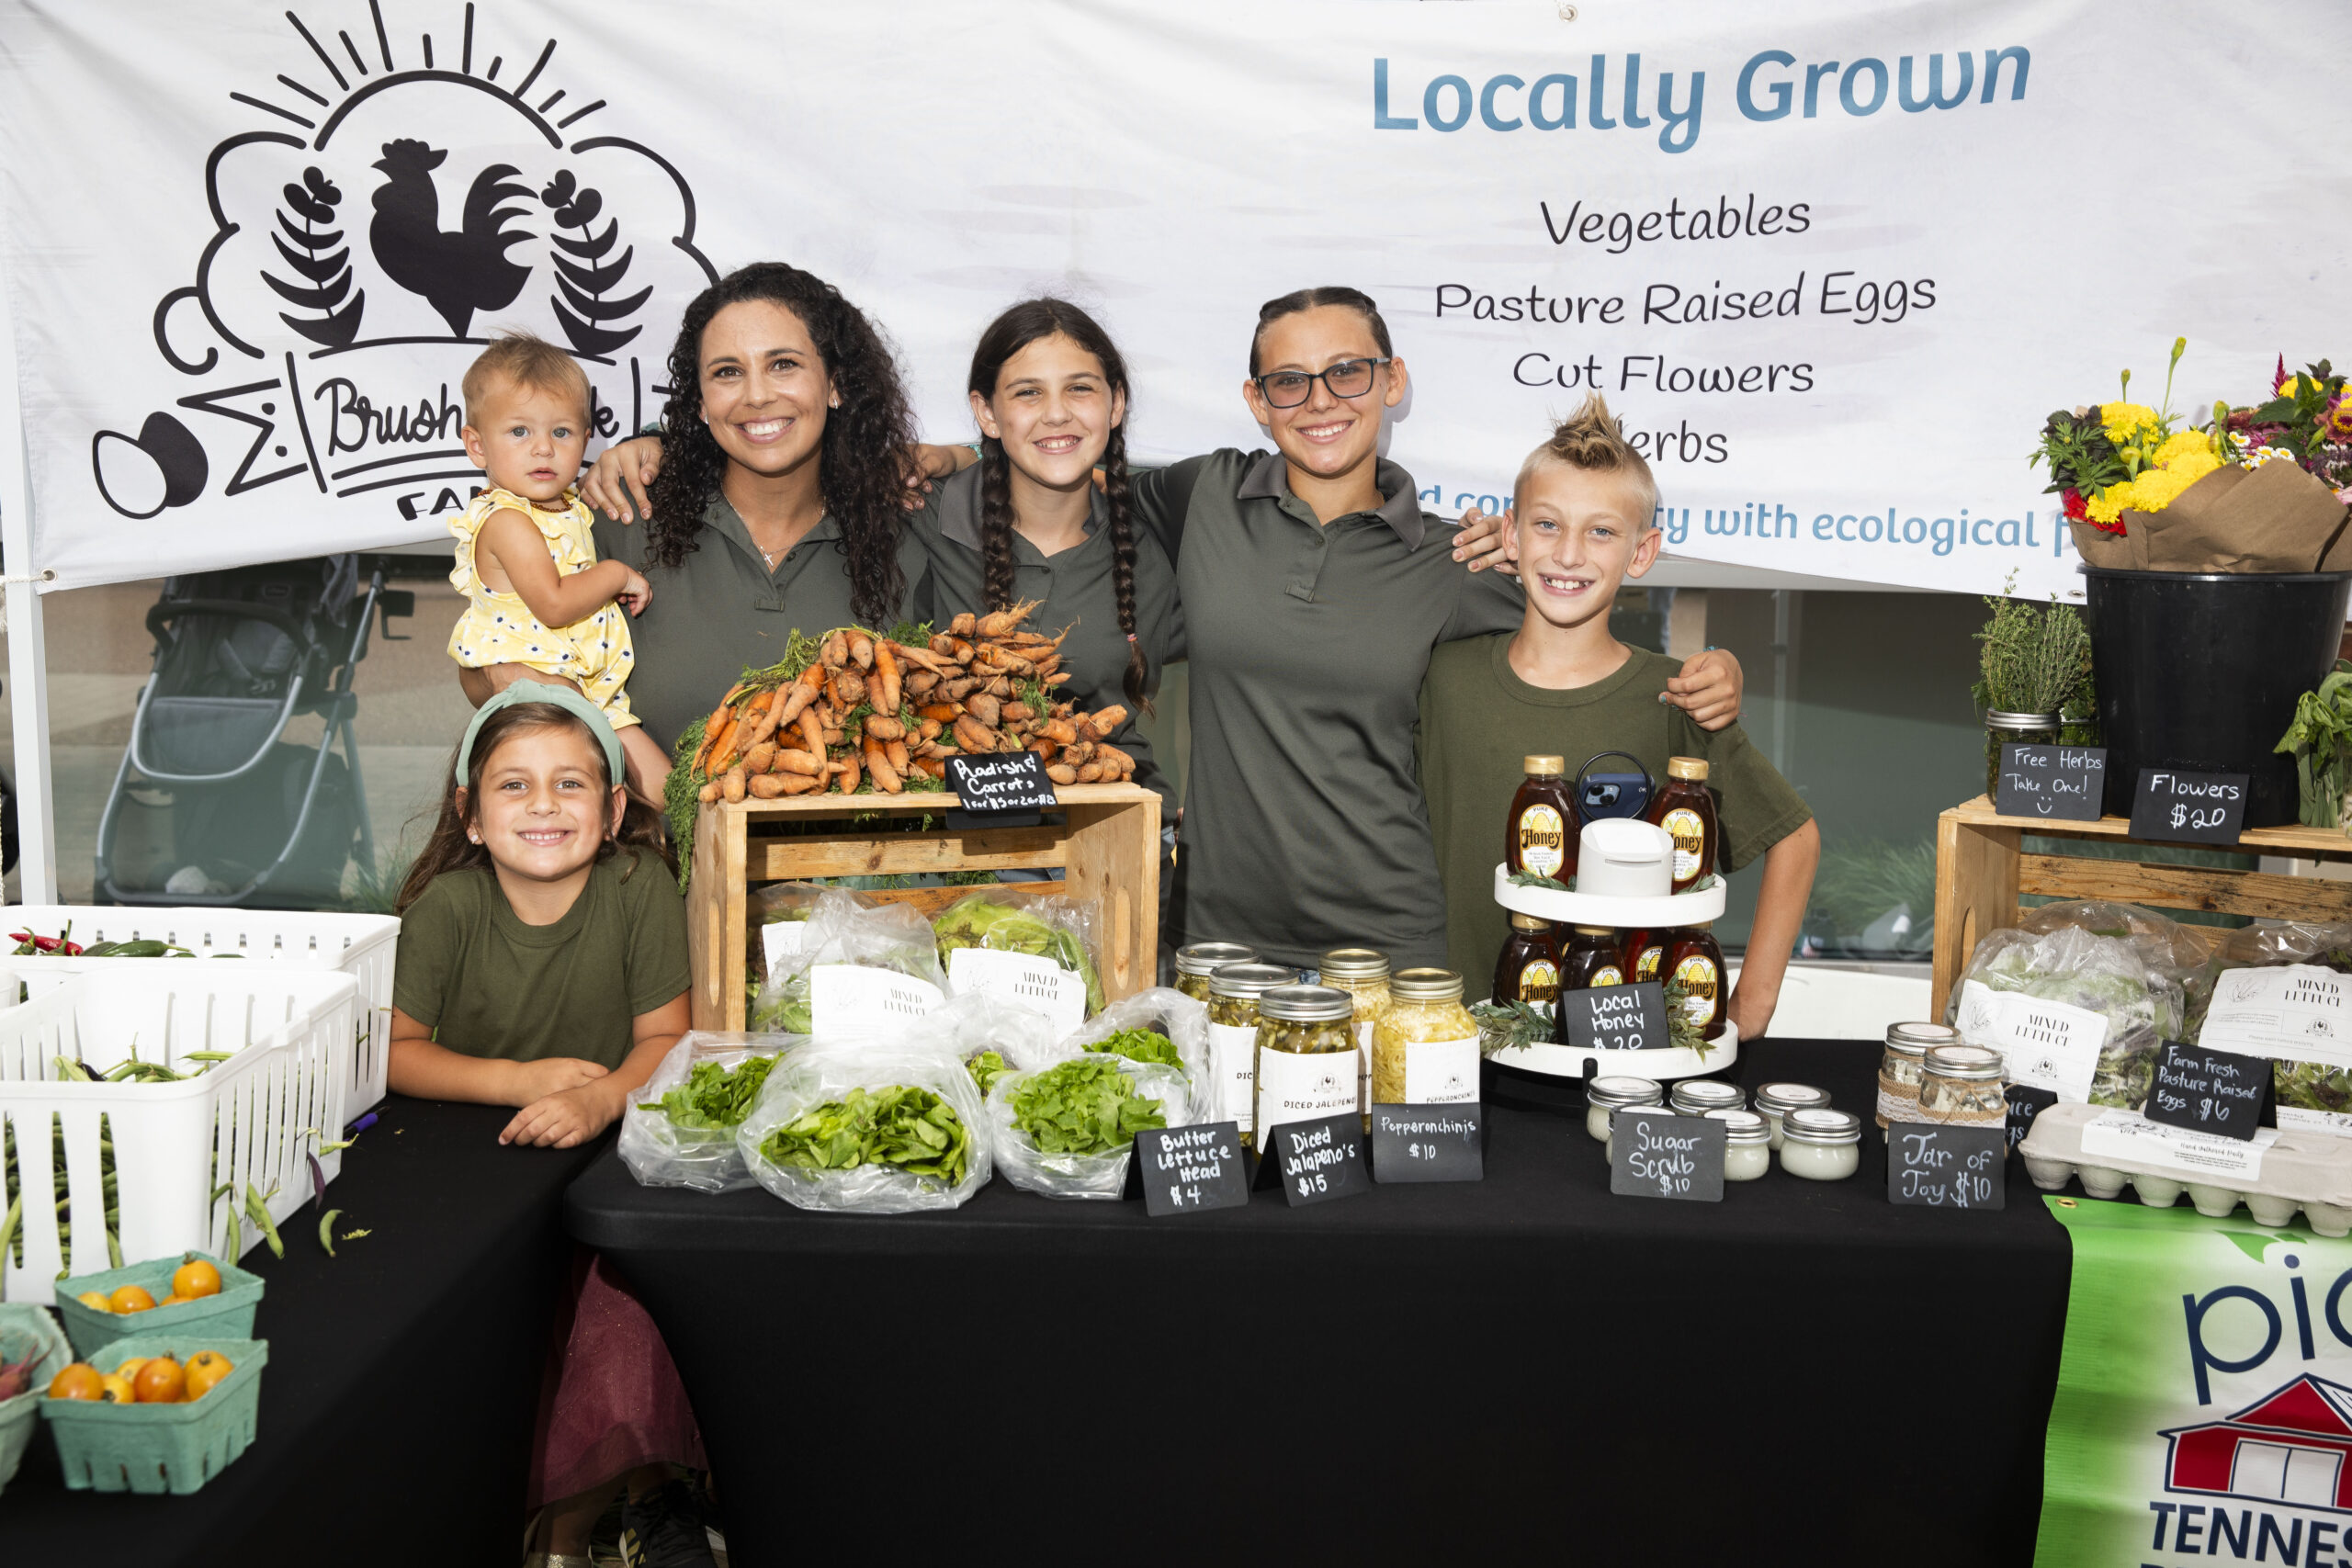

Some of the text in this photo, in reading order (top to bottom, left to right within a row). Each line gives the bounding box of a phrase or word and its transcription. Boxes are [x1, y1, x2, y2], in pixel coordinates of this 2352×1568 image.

[1374, 45, 2031, 154] Locally Grown
[1540, 194, 1811, 254] Vegetables
[1435, 270, 1938, 324] Pasture Raised Eggs
[1513, 352, 1815, 392] Cut Flowers
[1618, 420, 1728, 463] erbs
[1704, 502, 1798, 540] with
[1812, 506, 2041, 558] ecological
[954, 756, 1026, 780] Radish
[2015, 747, 2102, 770] Free Herbs
[967, 776, 1035, 795] Carrots
[2005, 773, 2087, 800] Take One!
[2151, 774, 2240, 800] Flowers
[2171, 803, 2226, 829] $20
[1521, 829, 1561, 850] Honey
[1668, 831, 1702, 854] oney
[1521, 985, 1557, 1003] Honey
[1590, 989, 1641, 1014] Local
[1591, 1013, 1645, 1032] Honey
[2167, 1045, 2240, 1077] Farm Fresh
[1236, 1072, 1252, 1080] DIC
[2159, 1066, 2256, 1100] Pasture Raised
[1283, 1100, 1313, 1110] DICED
[2156, 1089, 2230, 1121] Eggs $6
[1160, 1131, 1216, 1152] Butter
[1291, 1125, 1331, 1154] Diced
[1637, 1122, 1701, 1155] Sugar
[1903, 1132, 1953, 1168] Jar
[1180, 1160, 1221, 1183] Head
[1286, 1144, 1355, 1176] Jalapeno's
[1628, 1152, 1695, 1179] Scrub
[1297, 1174, 1328, 1197] $15
[1902, 1169, 1992, 1208] Joy $10
